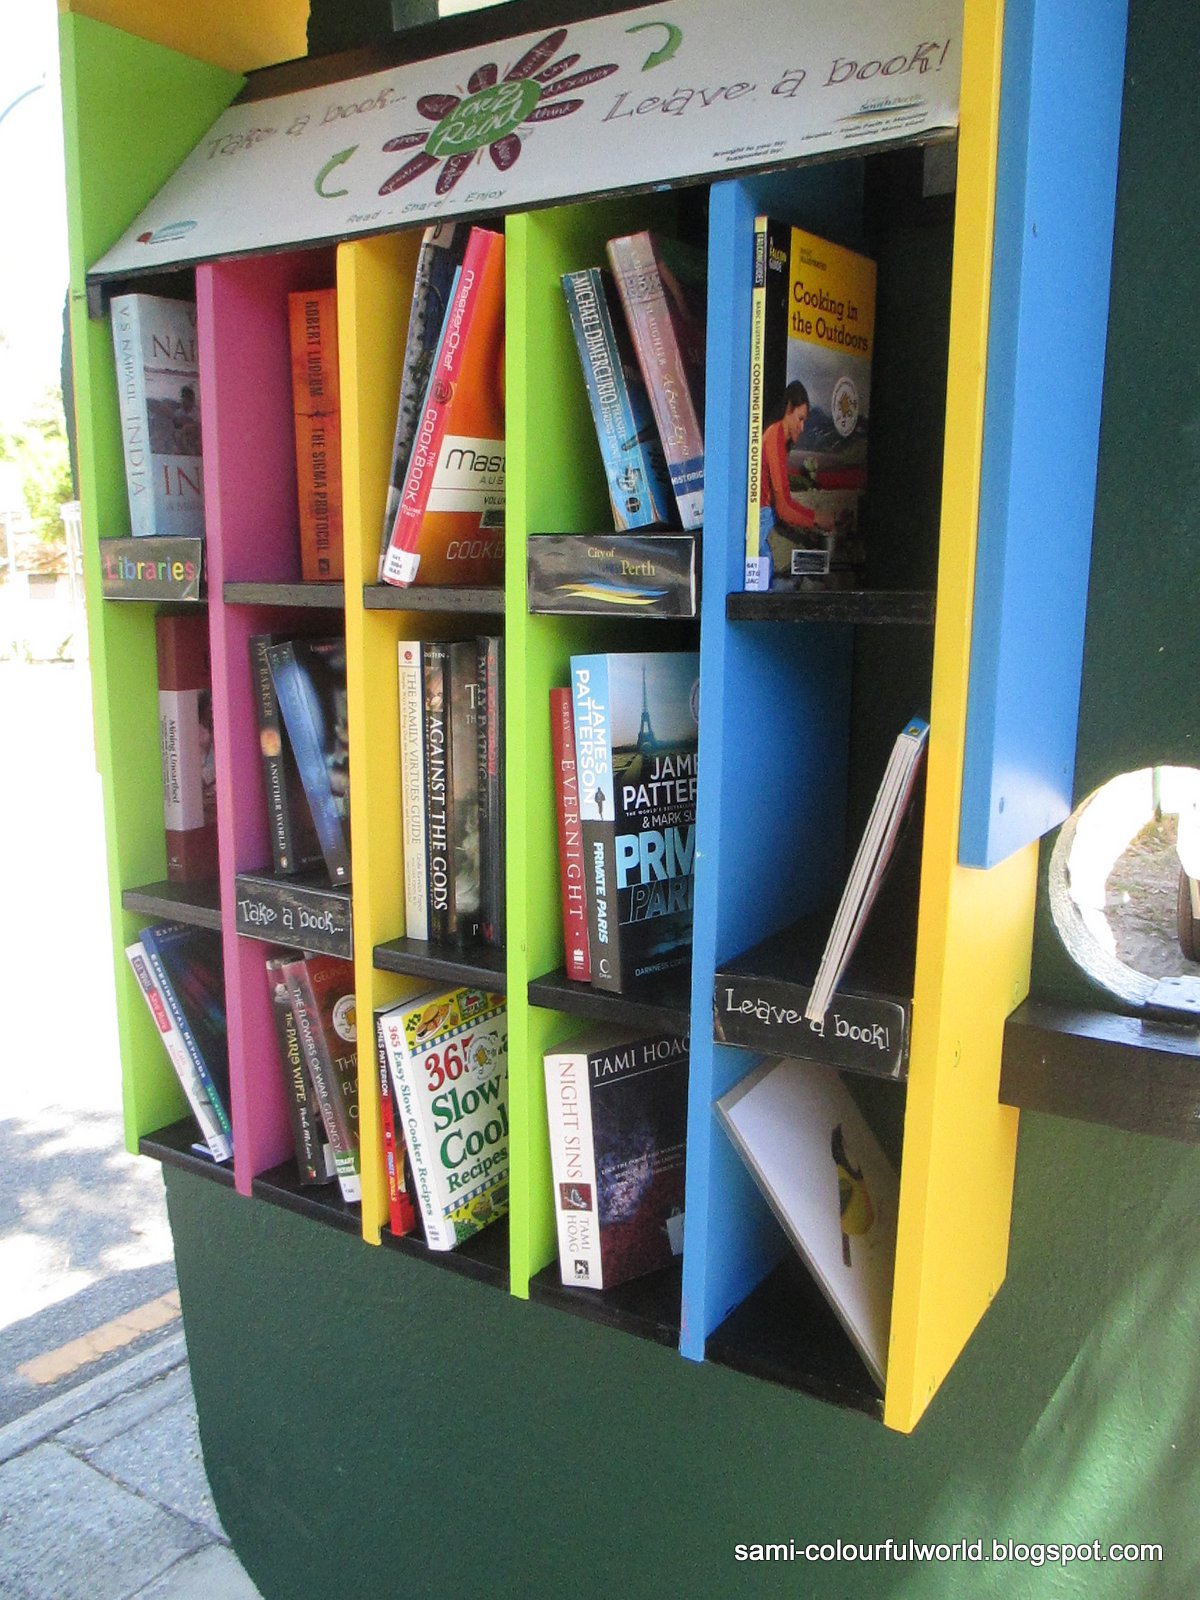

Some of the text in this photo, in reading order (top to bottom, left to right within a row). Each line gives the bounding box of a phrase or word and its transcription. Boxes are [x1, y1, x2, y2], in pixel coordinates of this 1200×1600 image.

[602, 39, 951, 122] Leave a book!
[207, 127, 279, 161] Take
[286, 114, 311, 137] a
[464, 188, 507, 205] Enjoy
[304, 300, 319, 348] ROBERT
[793, 281, 859, 320] Cooking in
[572, 277, 617, 404] MICHAEL DIMERCURIO
[792, 311, 869, 352] the Outdoors
[752, 363, 761, 411] COOKING
[312, 427, 326, 448] THE
[750, 424, 760, 445] THE
[751, 412, 760, 423] IN
[126, 415, 147, 497] INDIA
[311, 449, 327, 489] SIGMA
[404, 409, 438, 504] COOKBOOK
[445, 448, 505, 473] Mas
[749, 446, 759, 503] OUTDOORS
[105, 555, 196, 583] Libraries
[587, 547, 605, 560] City
[621, 559, 655, 578] Perth
[406, 671, 417, 697] THE
[407, 701, 419, 747] FAMILY
[576, 669, 599, 805] PATTERSON
[591, 700, 608, 775] JAMES
[409, 749, 420, 802] VIRTUES
[270, 761, 287, 850] ANOTHER WORLD
[410, 805, 421, 845] GUIDE
[429, 716, 448, 911] AGAINST THE GODS
[561, 702, 584, 921] GRAY EVERNIGHT
[642, 815, 650, 829] &
[651, 811, 682, 827] MARK
[593, 841, 608, 897] PRIVATE
[237, 899, 277, 926] Take
[282, 906, 294, 930] a
[597, 896, 609, 945] PARIS
[150, 954, 186, 1029] EXPERIMENTAL
[184, 1030, 207, 1080] METHODS
[299, 1004, 317, 1058] FLOWERS
[725, 988, 801, 1026] Leave
[833, 1014, 890, 1052] book!
[285, 1026, 301, 1066] PARIS
[310, 1056, 321, 1072] OF
[590, 1049, 636, 1078] TAMI
[292, 1065, 307, 1103] WIFE
[313, 1070, 328, 1100] WAR
[379, 1050, 389, 1097] PATTERSON
[388, 1025, 399, 1048] 365
[394, 1050, 405, 1079] Easy
[400, 1083, 412, 1116] Slow
[407, 1117, 423, 1168] Cooker
[418, 1166, 434, 1217] Recipes
[431, 1074, 502, 1133] Slow
[559, 1062, 583, 1178] NIGHT SINS
[446, 1146, 508, 1194] Recipes
[567, 1214, 580, 1253] HOAG
[579, 1216, 591, 1251] TAMI
